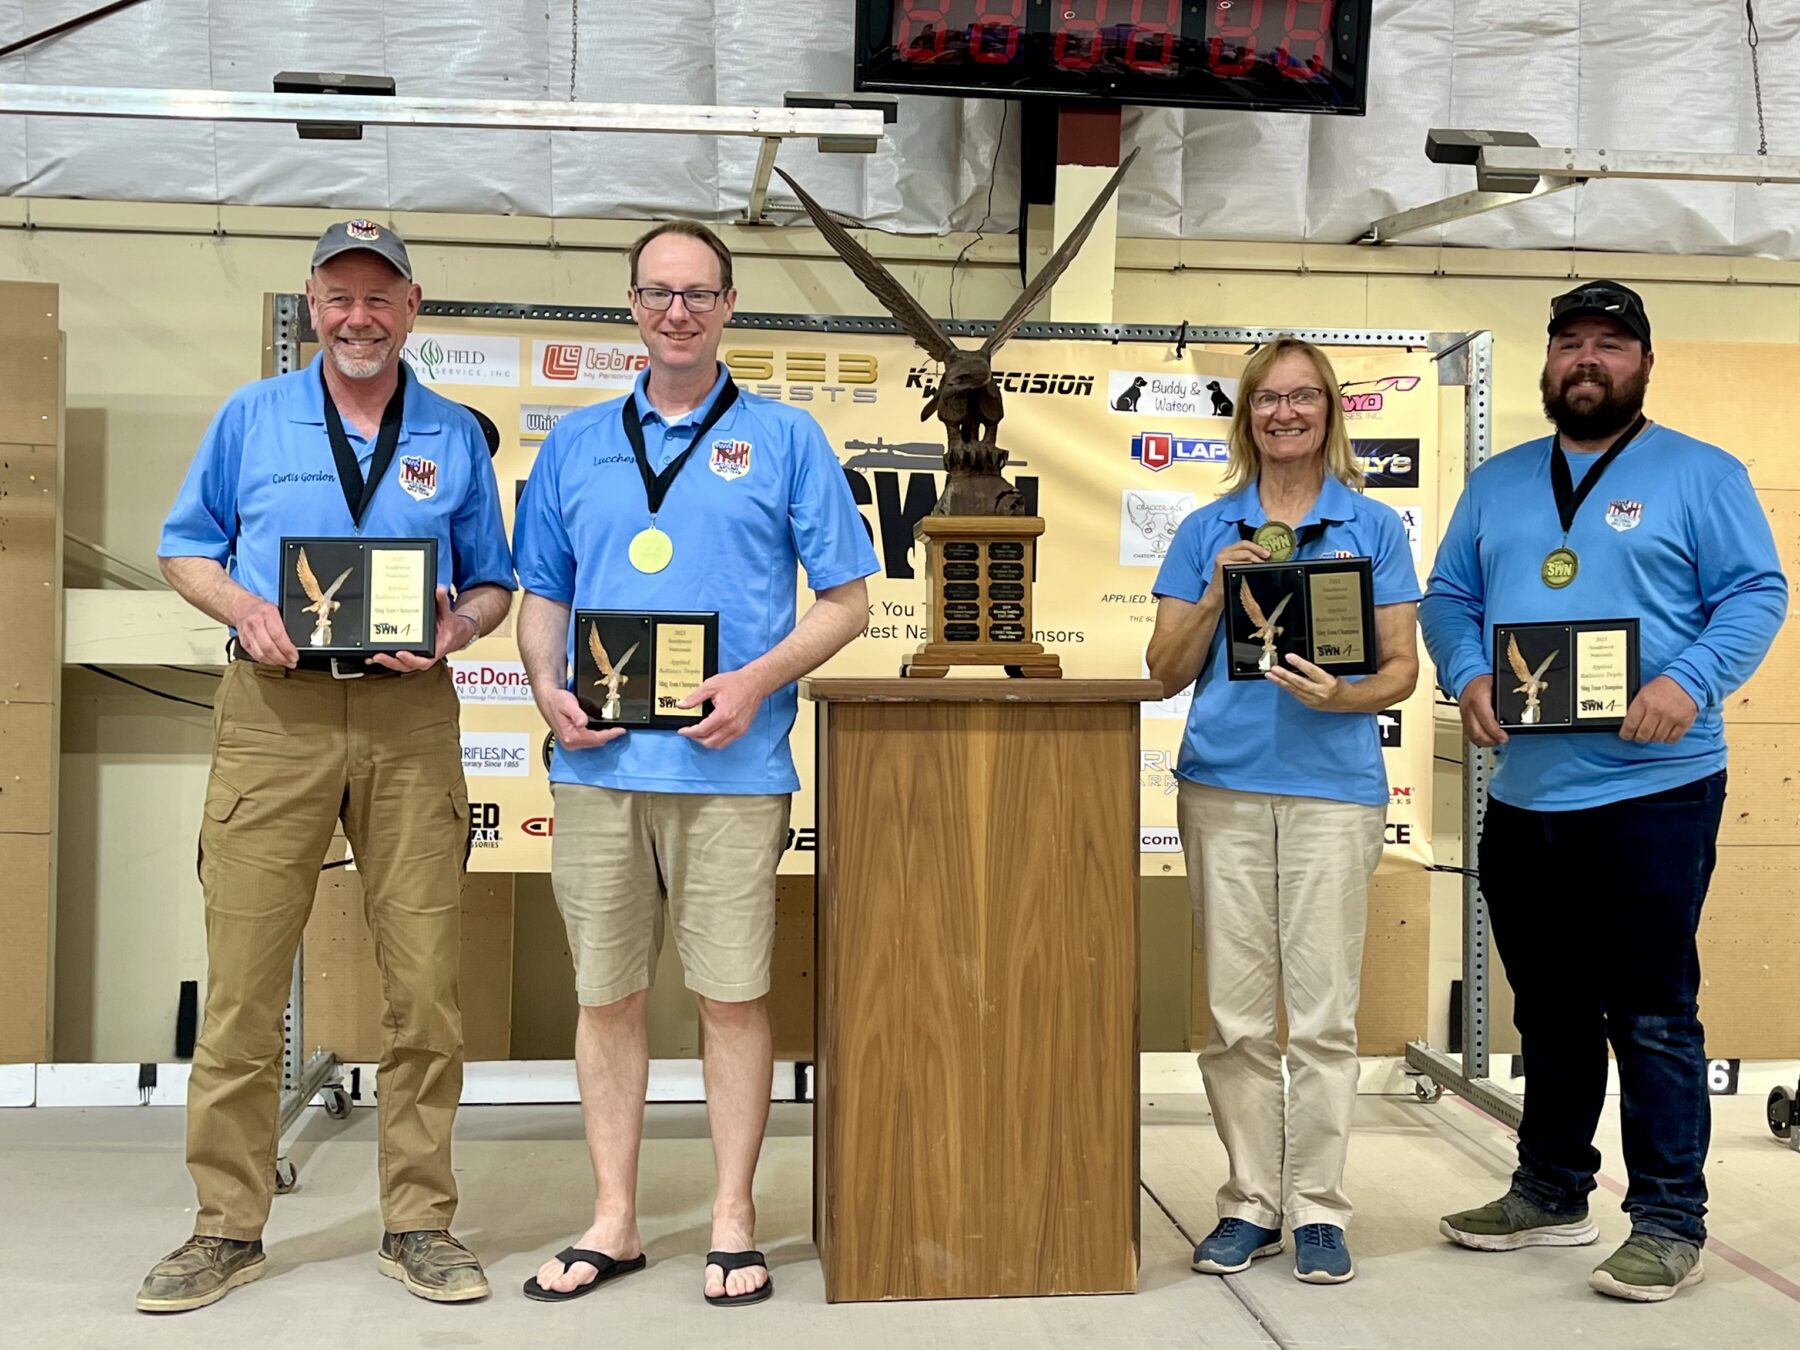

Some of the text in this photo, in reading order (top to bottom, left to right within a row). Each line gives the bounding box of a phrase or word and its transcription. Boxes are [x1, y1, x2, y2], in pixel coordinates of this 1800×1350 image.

[447, 350, 485, 365] FIELD
[725, 349, 879, 385] SEB
[1151, 379, 1201, 399] Buddy &
[1155, 397, 1196, 413] Watson
[1176, 441, 1231, 459] LAP
[272, 470, 336, 485] Curtis Gordon
[1101, 594, 1147, 604] APPLIED
[881, 600, 915, 617] You
[448, 667, 530, 686] acDona
[483, 760, 502, 768] Since
[503, 760, 519, 768] 1955
